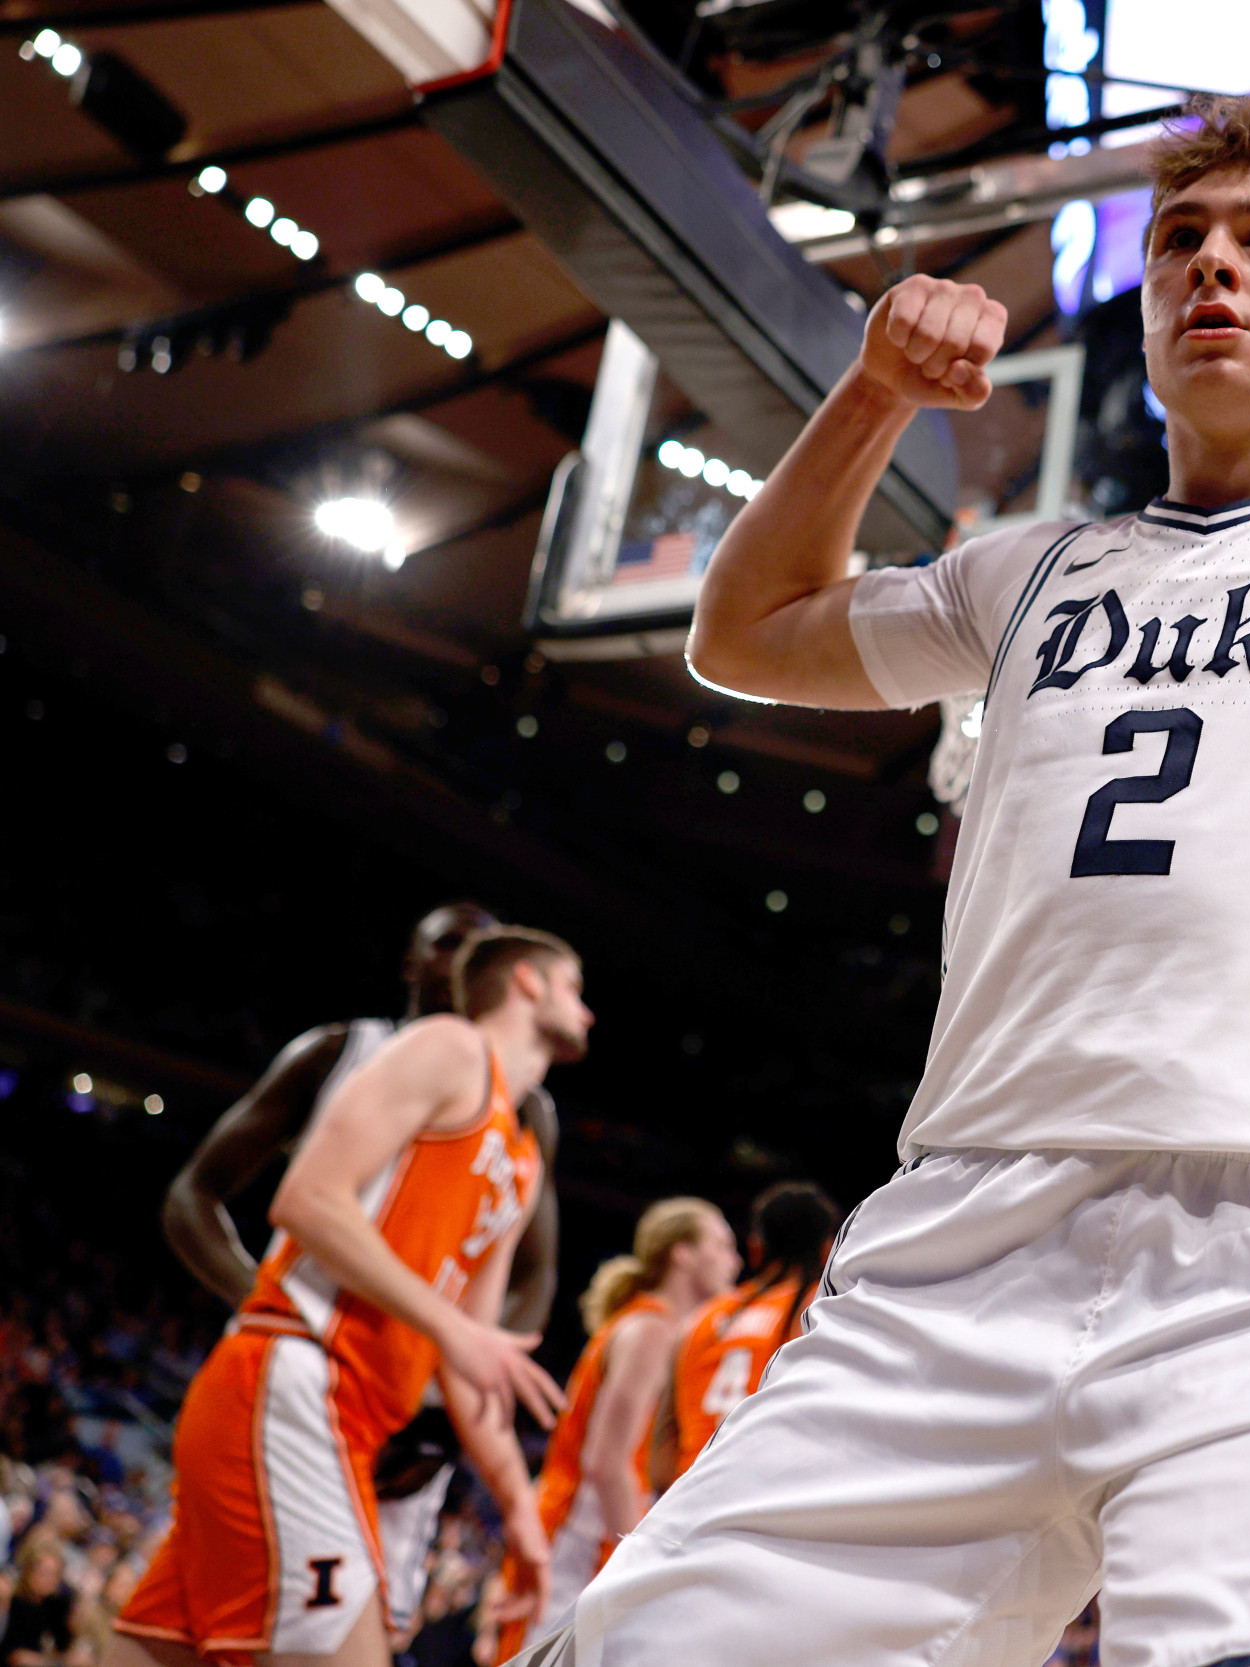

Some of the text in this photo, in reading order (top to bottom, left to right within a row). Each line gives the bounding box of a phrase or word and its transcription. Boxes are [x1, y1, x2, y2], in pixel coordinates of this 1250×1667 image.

[1070, 708, 1203, 878] 2
[702, 1346, 753, 1425] 4
[304, 1556, 344, 1610] I
